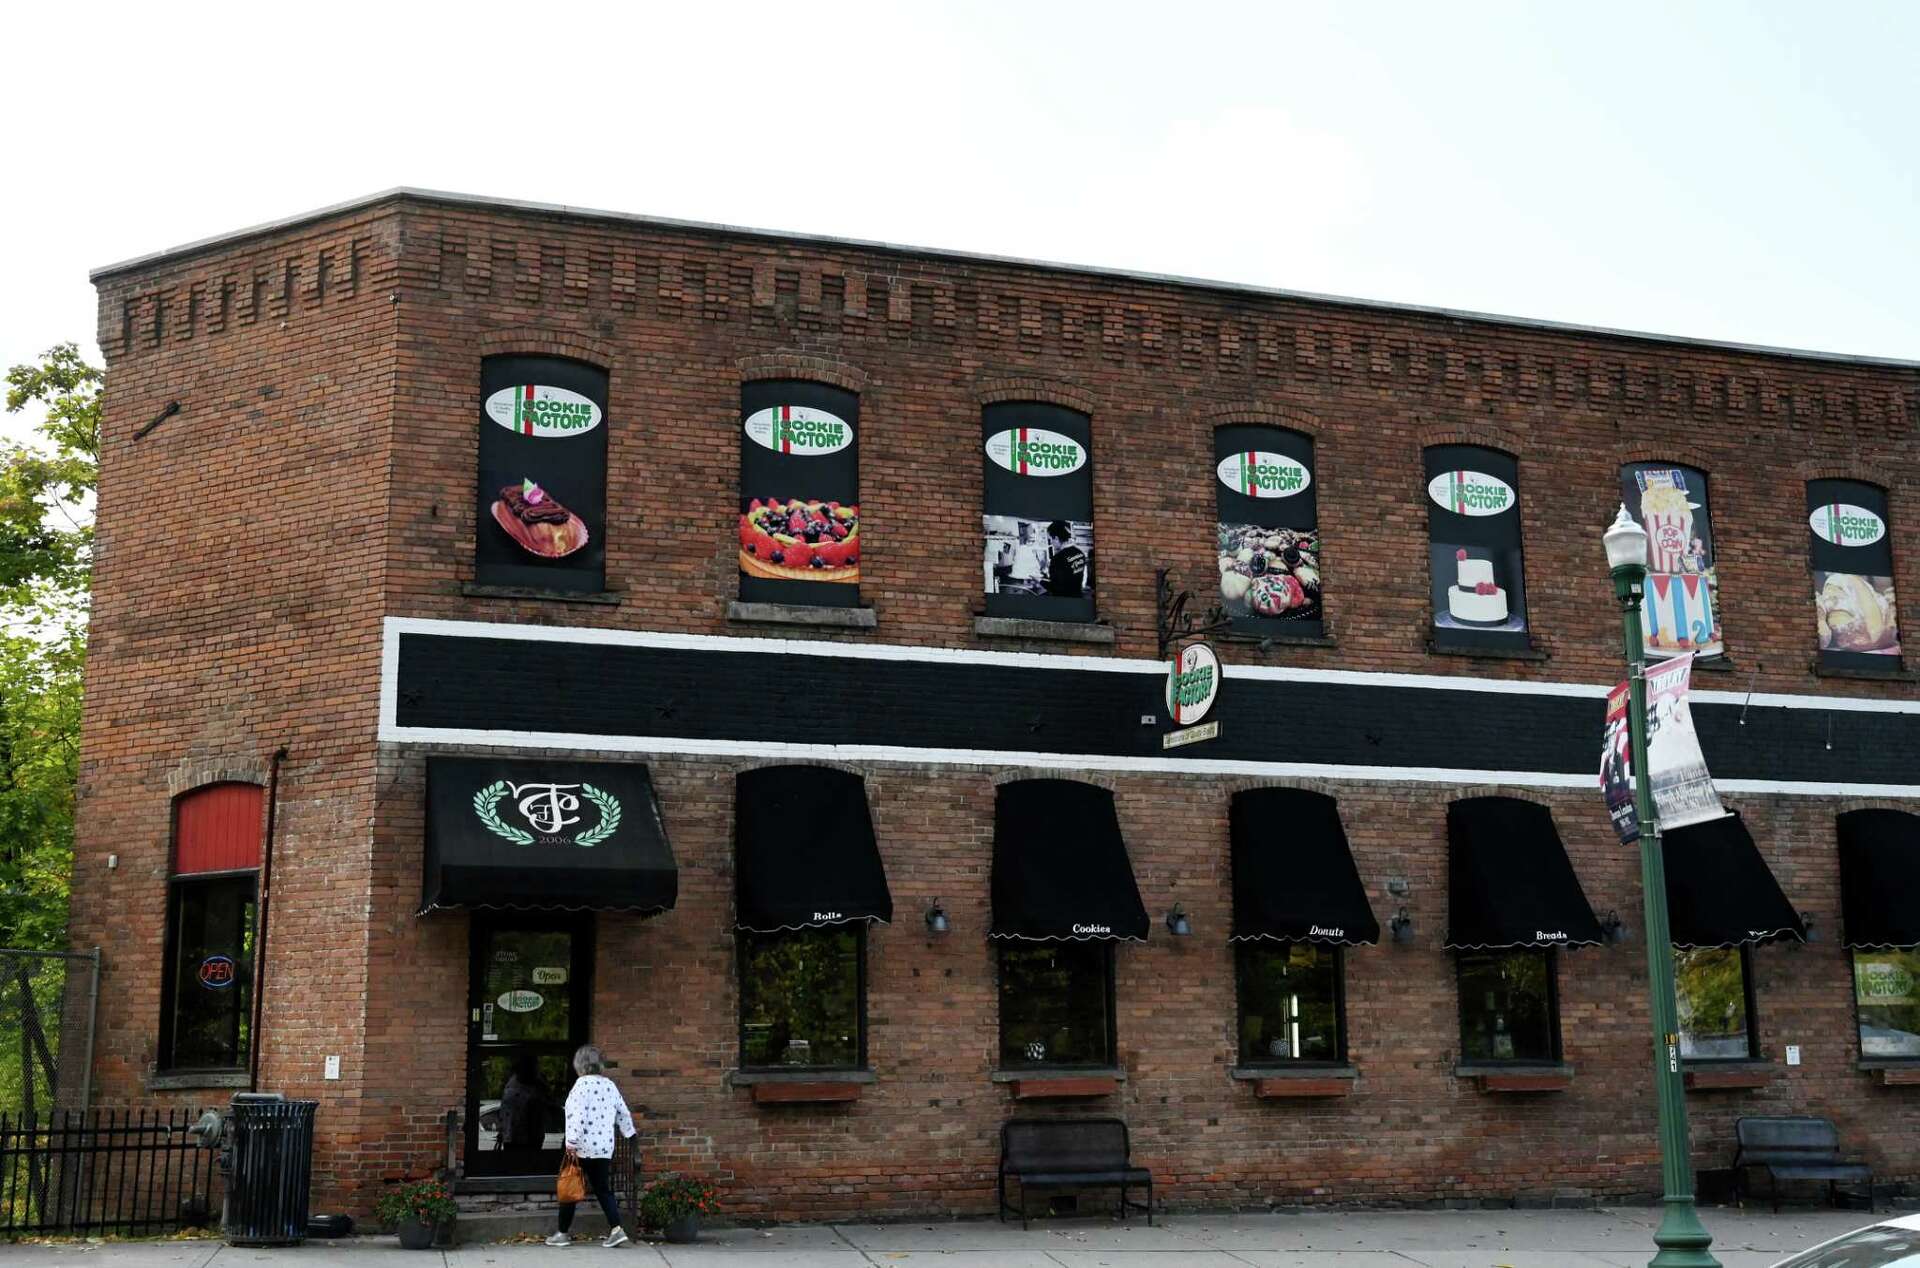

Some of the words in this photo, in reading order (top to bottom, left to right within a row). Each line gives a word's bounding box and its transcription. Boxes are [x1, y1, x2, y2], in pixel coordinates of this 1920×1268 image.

[523, 400, 592, 415] COOKIE
[522, 411, 592, 429] FACTORY
[780, 420, 843, 434] COOKIE
[780, 430, 844, 448] FACTORY
[1018, 442, 1077, 456] COOKIE
[1017, 451, 1078, 469] FACTORY
[1247, 464, 1302, 477] COOKIE
[1247, 474, 1303, 491] FACTORY
[1456, 484, 1507, 496] COOKIE
[1456, 493, 1508, 509] FACTORY
[1834, 525, 1879, 540] FACTORY
[813, 911, 842, 921] Rolls
[1072, 923, 1111, 933] Cookies
[1309, 924, 1345, 937] Donuts
[1536, 930, 1568, 941] Breads
[200, 962, 234, 981] OPEN
